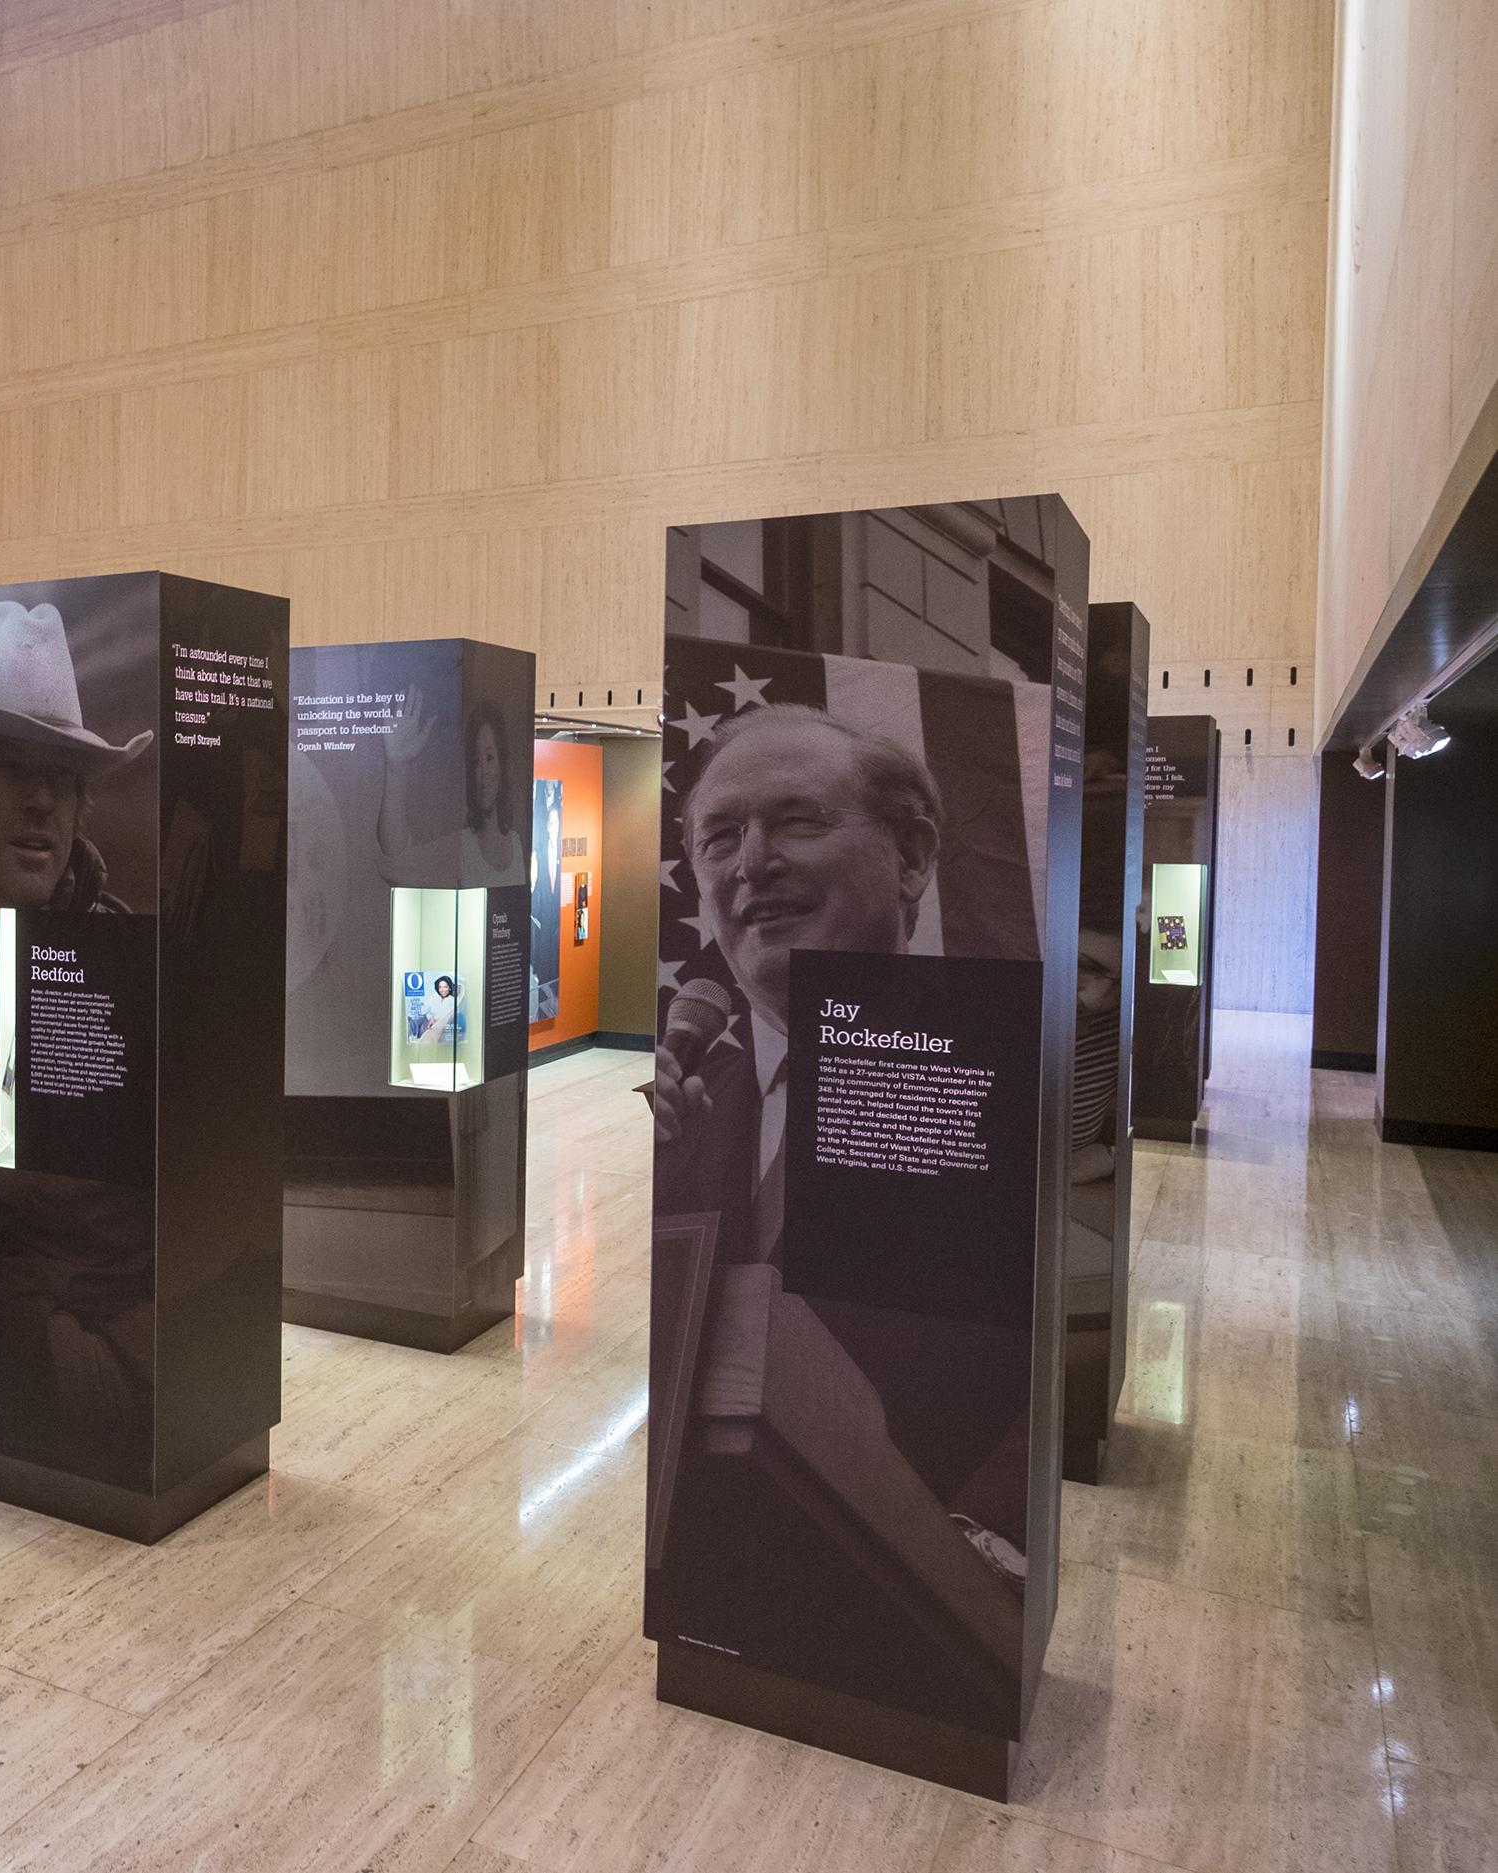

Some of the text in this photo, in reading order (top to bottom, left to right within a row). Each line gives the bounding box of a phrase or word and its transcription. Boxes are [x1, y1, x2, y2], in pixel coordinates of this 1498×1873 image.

[172, 644, 269, 669] "I'm astounded every time I
[175, 667, 273, 689] think about the fact that we
[175, 688, 274, 709] have this trail. It's a national
[345, 694, 355, 704] is
[356, 693, 373, 703] the
[375, 693, 393, 704] key
[395, 694, 405, 702] to
[297, 708, 402, 722] unlocking the world, a
[297, 724, 398, 738] passport to freedom."
[174, 733, 221, 748] Cheryl Strayed
[297, 741, 355, 752] Oprah Winfrey
[31, 945, 77, 963] Robert
[31, 965, 84, 984] Redford
[407, 973, 423, 990] O
[820, 999, 860, 1022] Jay
[819, 1025, 953, 1053] Rockefeller
[818, 1055, 832, 1064] Jay
[834, 1056, 876, 1067] Rockefeller
[878, 1060, 894, 1069] first
[930, 1065, 951, 1073] West
[952, 1066, 985, 1076] Virginia
[986, 1069, 995, 1077] in
[818, 1076, 845, 1086] mining
[846, 1079, 891, 1089] community
[903, 1083, 941, 1094] Emmons,
[943, 1088, 987, 1097] population
[856, 1069, 899, 1079] 27-year-old
[901, 1072, 926, 1081] VISTA
[927, 1076, 966, 1085] volunteer
[978, 1079, 992, 1087] the
[836, 1087, 847, 1095] He
[848, 1089, 884, 1098] arranged
